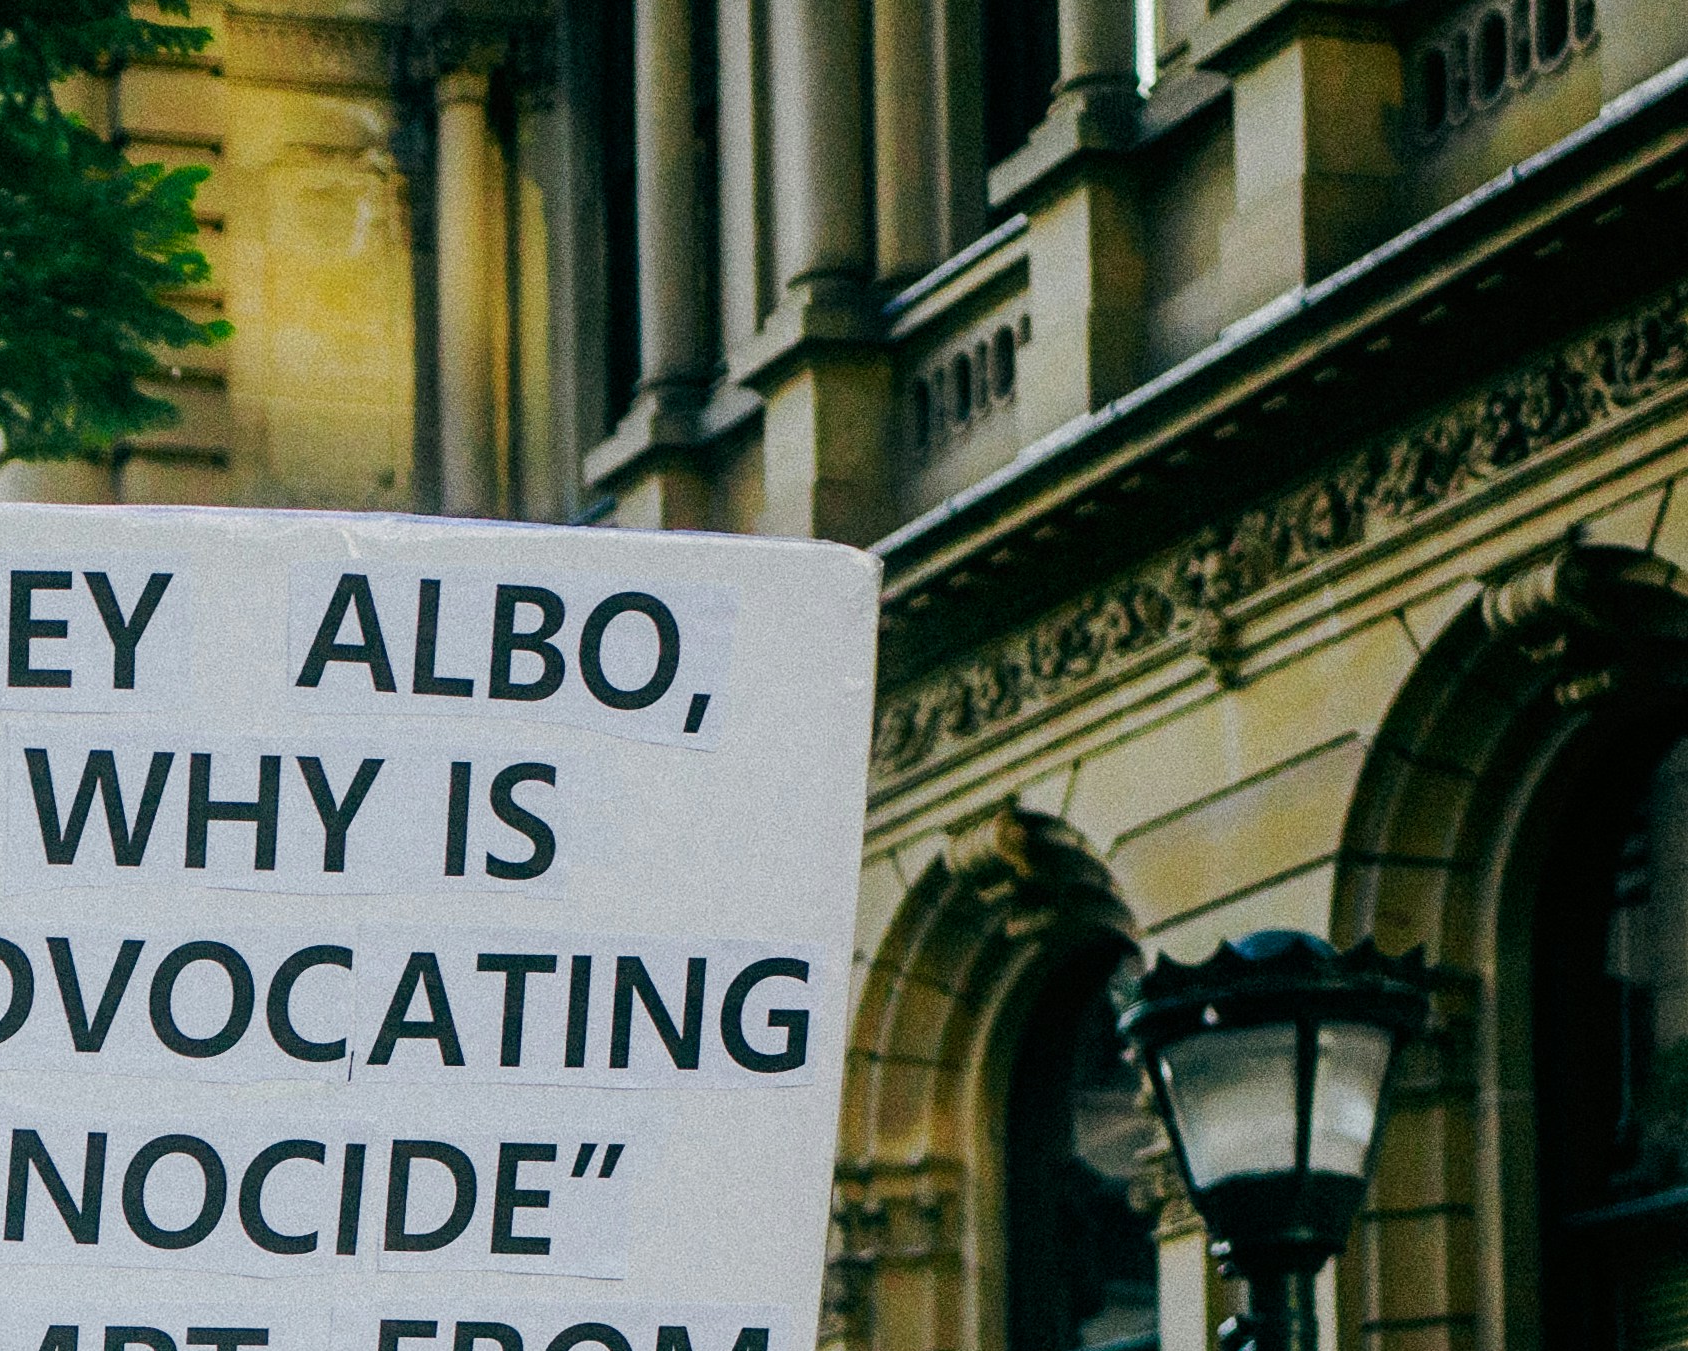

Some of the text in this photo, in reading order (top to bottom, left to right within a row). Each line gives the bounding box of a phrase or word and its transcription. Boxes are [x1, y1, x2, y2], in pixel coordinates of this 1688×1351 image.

[294, 571, 713, 734] ALBO,
[23, 747, 558, 881] WHY IS
